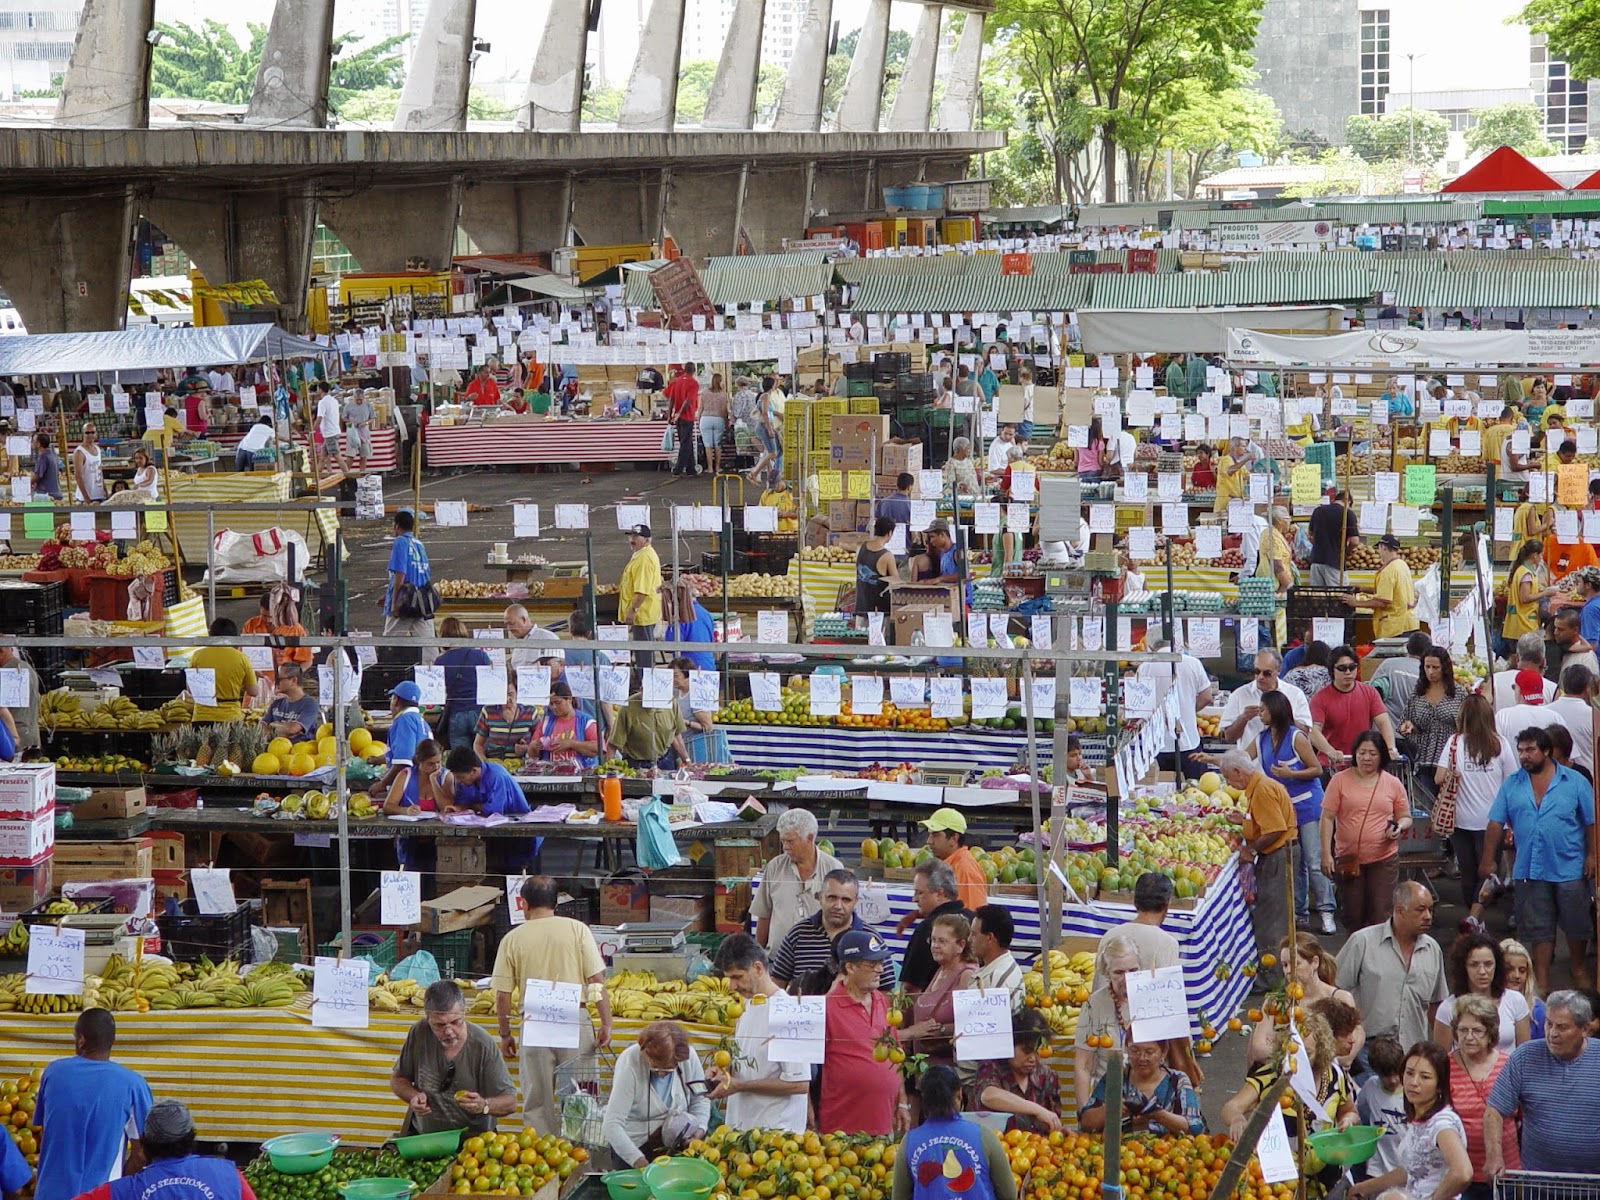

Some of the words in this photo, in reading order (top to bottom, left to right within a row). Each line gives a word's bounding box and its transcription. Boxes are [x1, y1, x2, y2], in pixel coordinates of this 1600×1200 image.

[1223, 224, 1259, 232] PRODUTOS
[1106, 672, 1117, 748] TECO
[928, 1135, 982, 1175] SELECIONADAS
